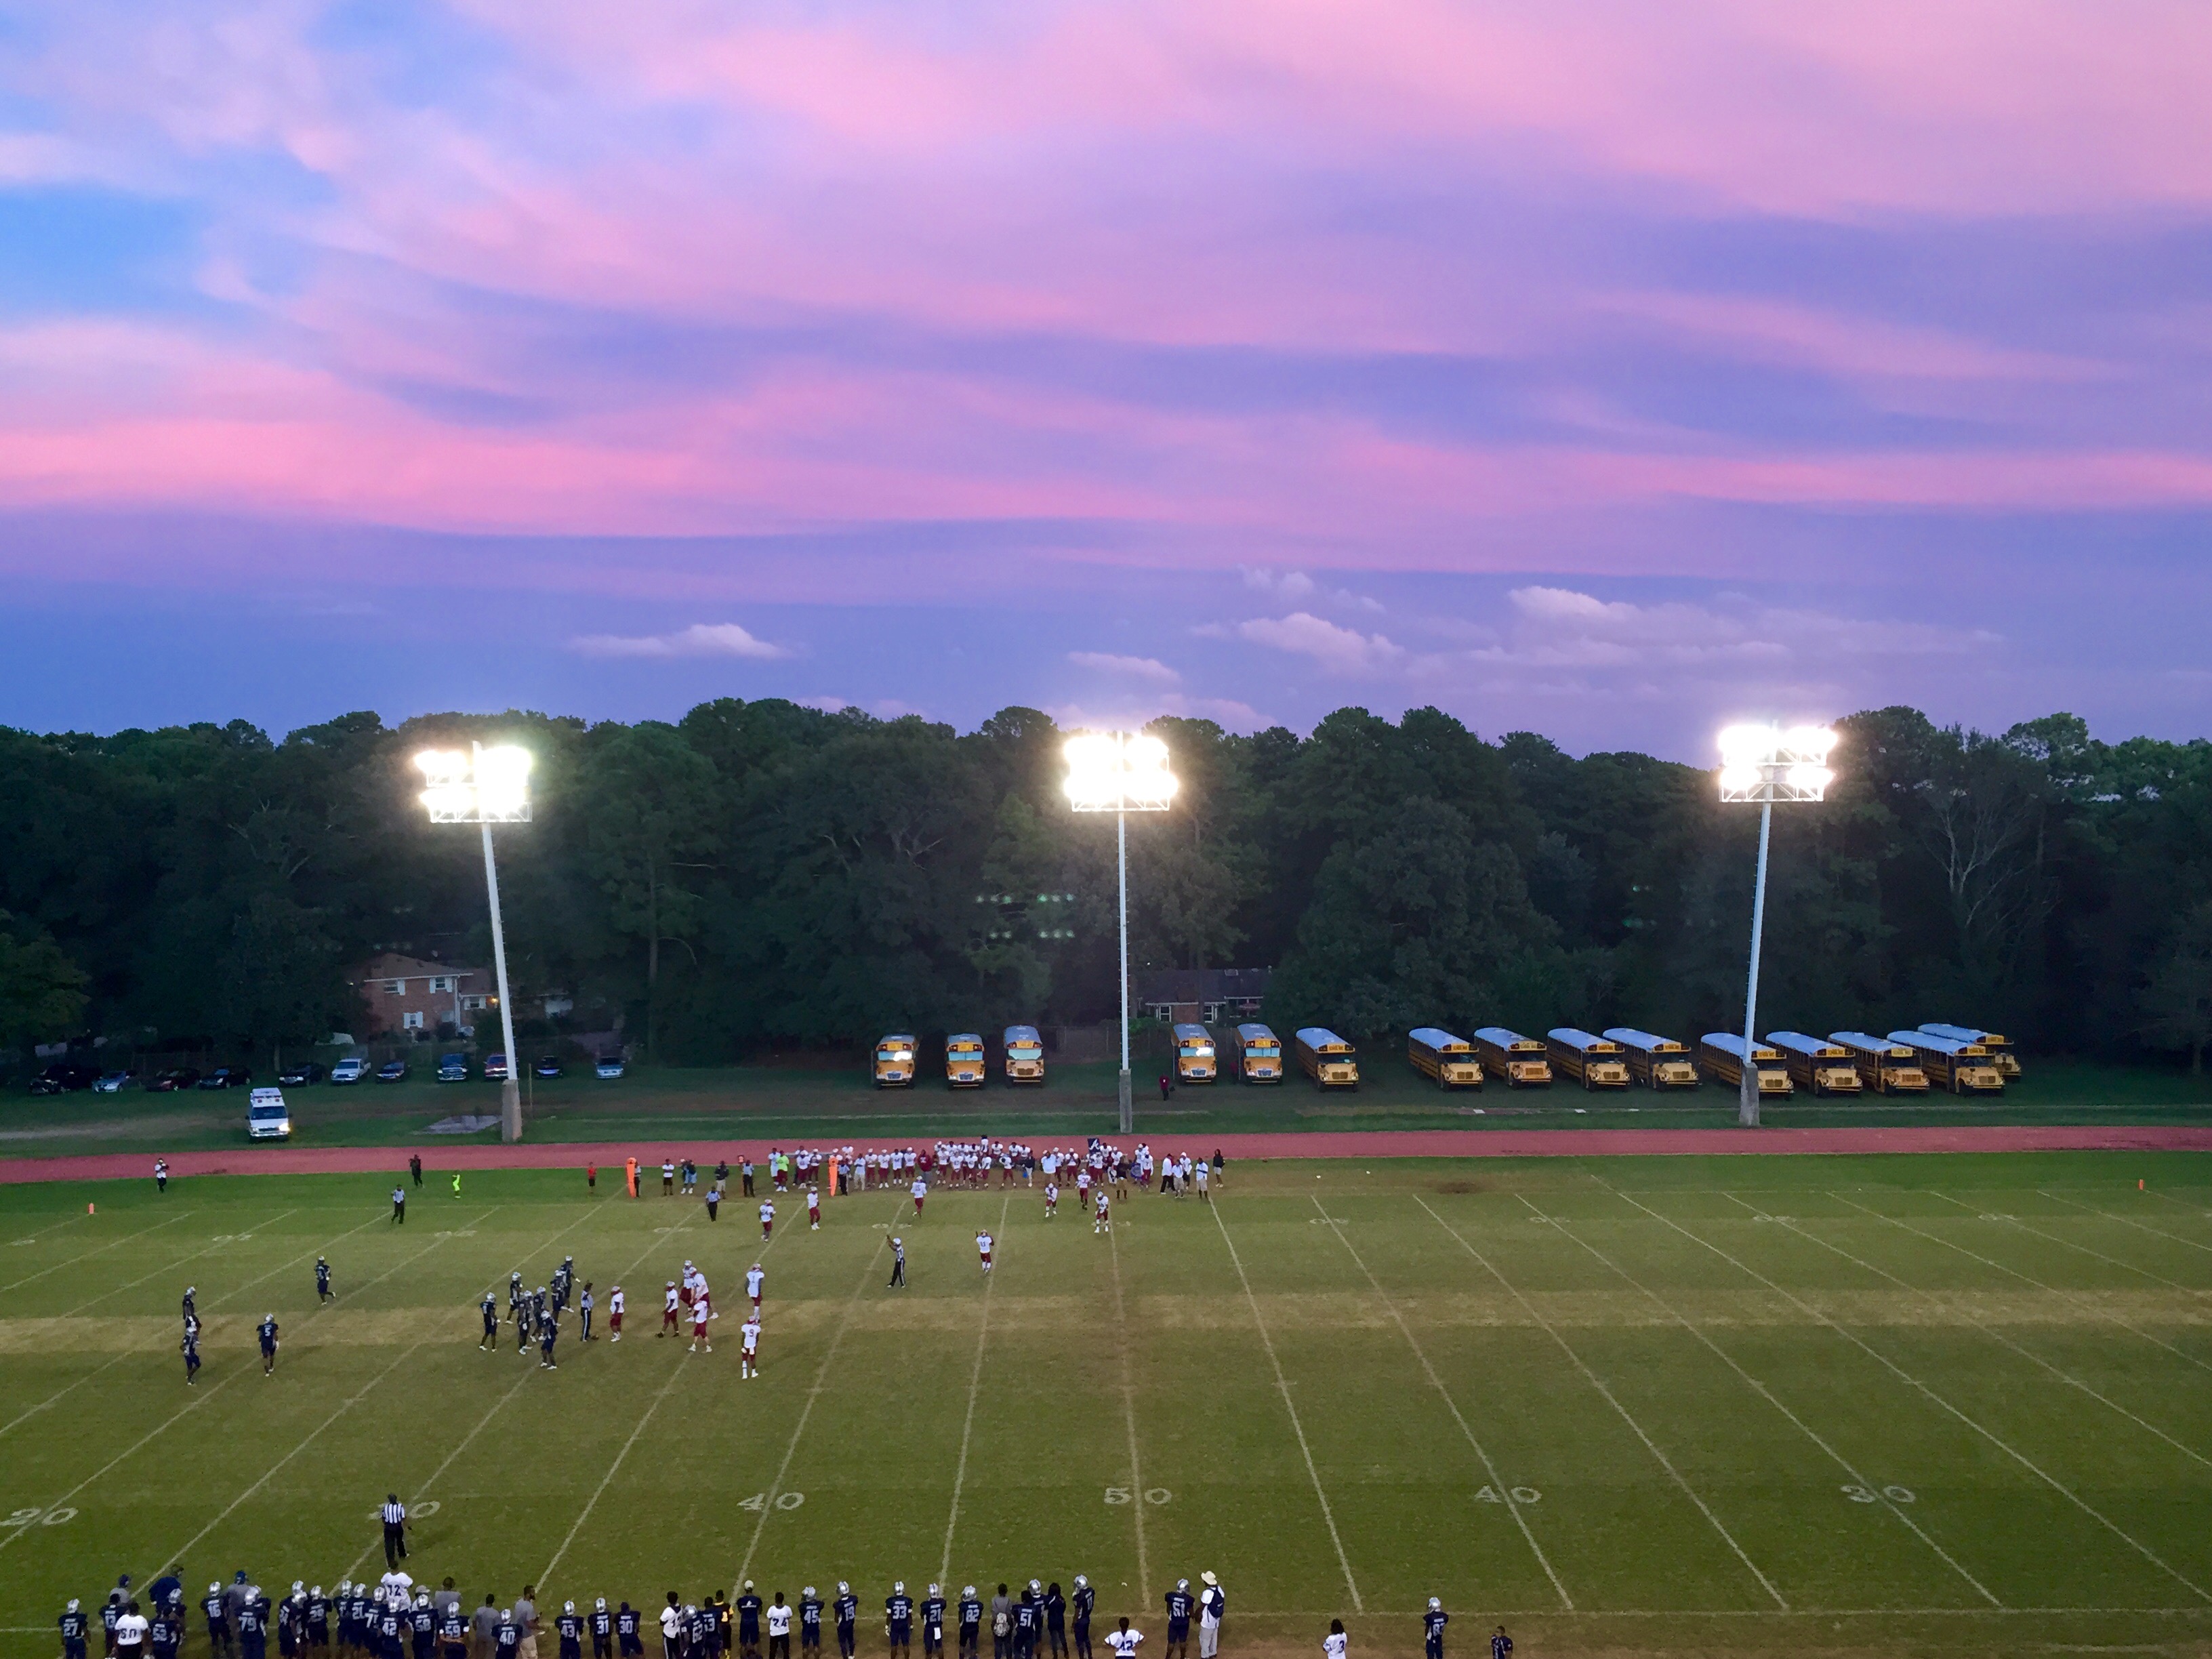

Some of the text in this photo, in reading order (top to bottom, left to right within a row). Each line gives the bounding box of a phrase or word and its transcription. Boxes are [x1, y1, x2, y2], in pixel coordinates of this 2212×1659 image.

[265, 1328, 271, 1336] 5
[750, 1329, 754, 1337] 9
[736, 1492, 806, 1511] 40
[1104, 1487, 1172, 1504] 50
[1474, 1485, 1542, 1504] 40
[1840, 1485, 1917, 1504] 30
[804, 1610, 820, 1624] 45
[844, 1605, 855, 1622] 19
[893, 1605, 907, 1620] 33
[929, 1608, 942, 1622] 21
[965, 1609, 980, 1623] 82
[1019, 1612, 1032, 1627] 51
[63, 1622, 79, 1637] 27
[238, 1616, 257, 1632] 79
[382, 1622, 397, 1636] 42
[560, 1624, 575, 1638] 43
[596, 1620, 609, 1634] 31
[618, 1620, 634, 1634] 30
[445, 1624, 461, 1639] 59
[499, 1631, 516, 1645] 40
